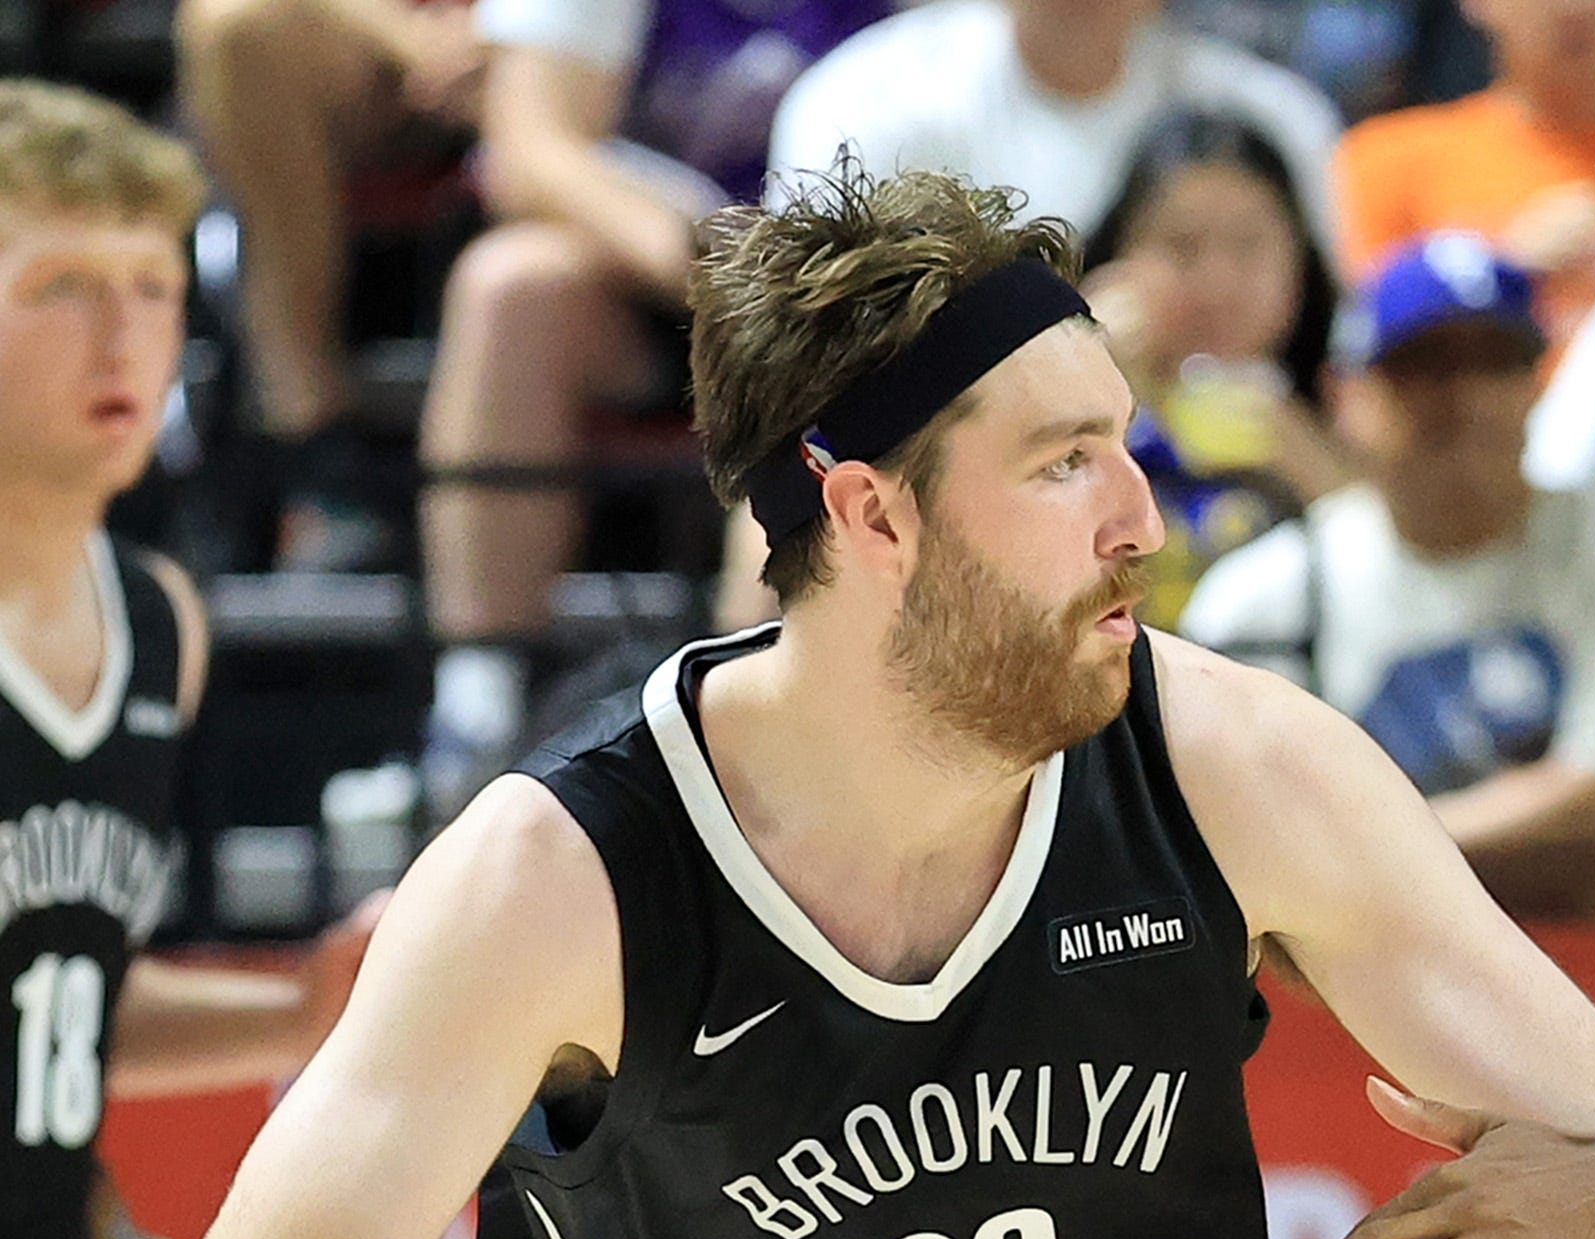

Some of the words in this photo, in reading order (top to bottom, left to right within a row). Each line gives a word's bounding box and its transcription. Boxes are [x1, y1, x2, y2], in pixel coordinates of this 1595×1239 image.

[1059, 922, 1094, 963] All
[1095, 920, 1125, 955] In
[1122, 912, 1185, 949] Won
[11, 952, 106, 1149] 18
